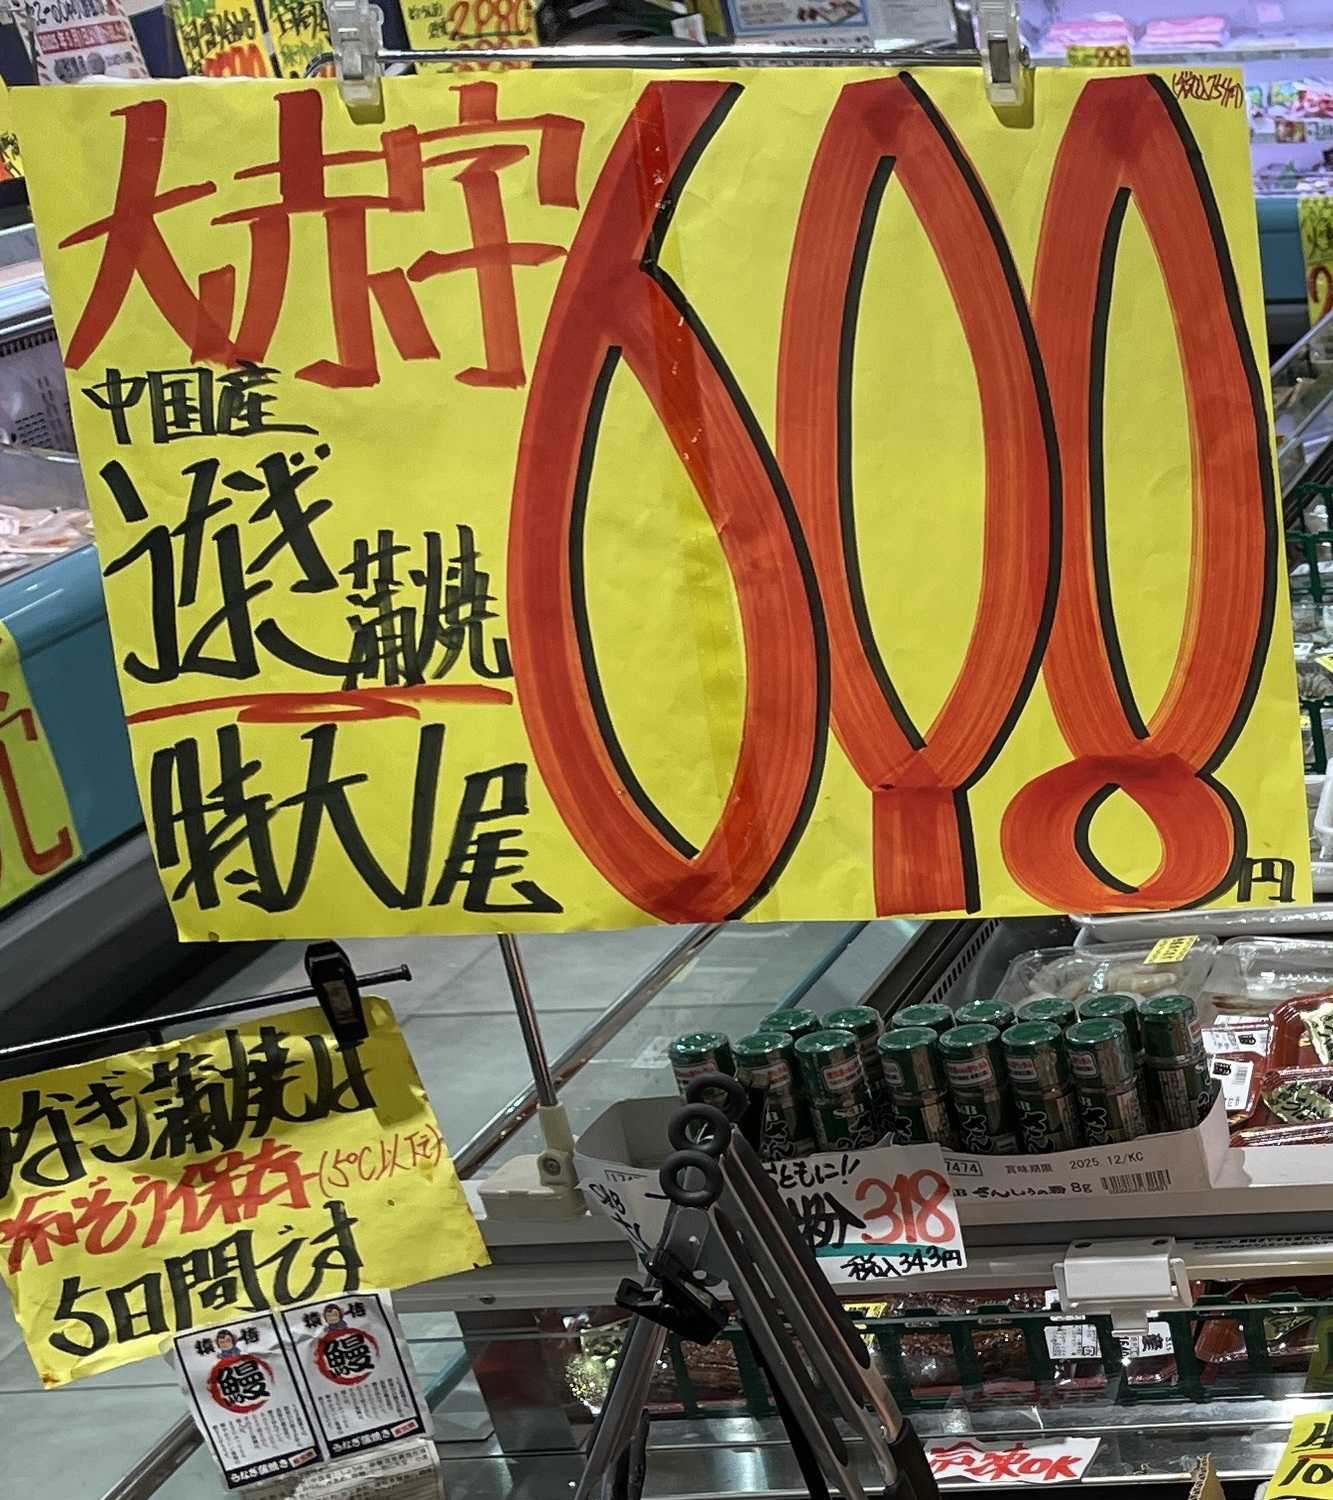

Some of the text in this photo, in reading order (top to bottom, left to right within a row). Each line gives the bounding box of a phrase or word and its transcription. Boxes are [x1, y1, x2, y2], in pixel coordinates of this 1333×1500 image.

[59, 81, 584, 389] 大赤字
[82, 360, 319, 445] 中国産
[340, 523, 513, 691] 蒲焼
[151, 722, 564, 913] 特大1尾
[0, 1026, 377, 1198] なぎ蒲焼は
[1069, 1179, 1092, 1195] 8g
[49, 1198, 364, 1358] 5日間です
[853, 1167, 958, 1245] 318
